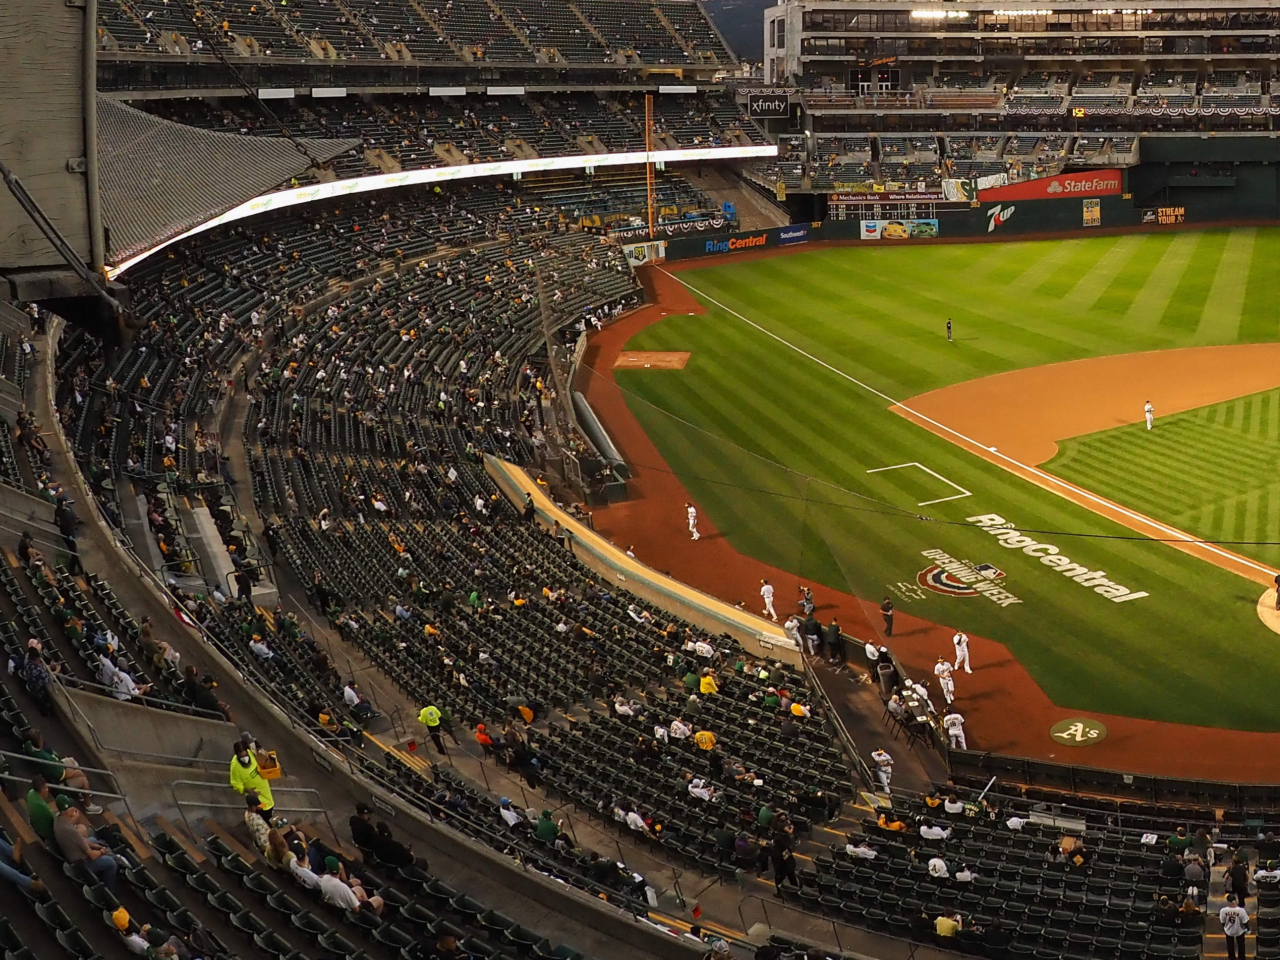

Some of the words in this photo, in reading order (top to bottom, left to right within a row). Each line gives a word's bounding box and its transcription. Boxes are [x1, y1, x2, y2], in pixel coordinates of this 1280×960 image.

[752, 98, 786, 113] xfinity
[1158, 207, 1185, 216] STREAM
[1158, 215, 1175, 224] YOUR
[780, 230, 804, 239] Southwest
[705, 234, 768, 253] RingCentral
[965, 513, 1150, 603] RingCentral
[921, 548, 984, 583] OPENING
[972, 580, 1023, 607] WEEK
[1053, 722, 1100, 741] A's
